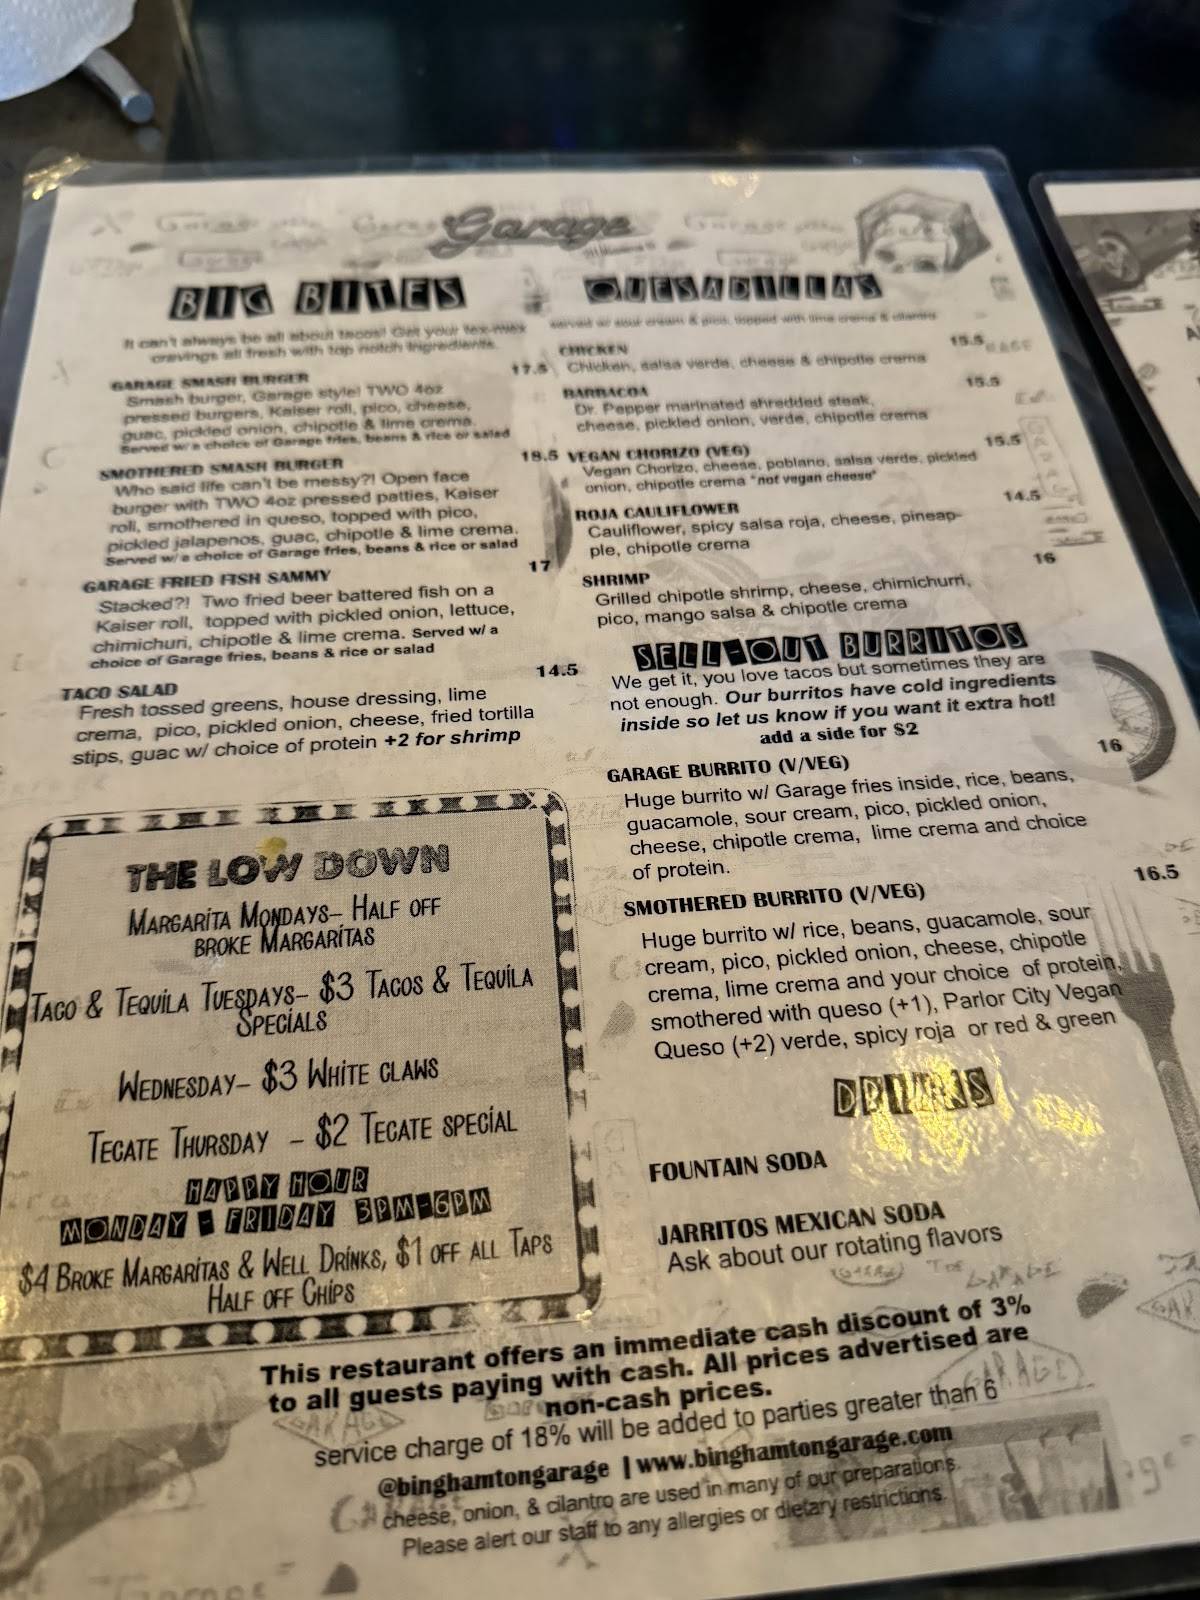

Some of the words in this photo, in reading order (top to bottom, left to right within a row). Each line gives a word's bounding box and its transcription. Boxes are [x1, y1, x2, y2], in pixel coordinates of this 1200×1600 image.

[432, 206, 636, 256] Garage
[168, 284, 274, 321] BIG
[295, 276, 467, 315] BITES
[583, 273, 883, 304] QUESADILLAS
[557, 343, 629, 355] CHICKEN
[950, 335, 984, 348] 15.5
[109, 377, 174, 392] GARAGE
[179, 374, 237, 388] SMASH
[239, 371, 309, 386] BURGER
[511, 363, 548, 377] 17.5
[965, 375, 1000, 389] 15.5
[561, 386, 648, 399] BARBACOA
[567, 448, 620, 462] VEGAN
[625, 446, 700, 460] CHORIZO
[705, 444, 750, 458] (VEG)
[985, 434, 1021, 448] 15.5
[98, 463, 204, 481] SMOTHERED
[208, 460, 267, 475] SMASH
[272, 456, 343, 472] BURGER
[522, 450, 559, 463] 18.5
[574, 506, 618, 520] ROJA
[623, 501, 739, 518] CAULIFLOWER
[1004, 490, 1040, 503] 14.5
[587, 520, 689, 537] Cauliflower,
[688, 517, 734, 537] spicy
[739, 515, 784, 531] salsa
[788, 517, 824, 533] roja,
[830, 511, 895, 527] cheese,
[900, 508, 962, 529] pineap-
[529, 560, 551, 574] 17
[1033, 552, 1056, 565] 16
[82, 576, 152, 593] GARAGE
[158, 573, 214, 589] FRIED
[218, 571, 261, 587] FISH
[266, 569, 330, 585] SAMMY
[582, 571, 649, 588] SHRIMP
[595, 588, 651, 606] Grilled
[657, 585, 725, 606] chipotle
[729, 583, 794, 602] shrimp,
[798, 580, 866, 596] cheese,
[95, 616, 153, 633] Kaiser
[158, 613, 192, 632] roll,
[203, 610, 269, 632] topped
[274, 608, 312, 625] with
[316, 605, 382, 628] pickled
[387, 603, 443, 621] onion,
[448, 602, 514, 618] lettuce,
[633, 633, 828, 672] SELL-OUT
[840, 623, 1028, 659] BURRITOS
[537, 664, 578, 679] 14.5
[611, 673, 642, 689] We
[647, 672, 676, 692] get
[681, 669, 698, 687] it,
[701, 670, 735, 689] you
[740, 666, 778, 682] love
[783, 665, 833, 679] tacos
[836, 660, 867, 676] but
[871, 655, 969, 674] sometimes
[973, 651, 1012, 671] they
[1017, 652, 1046, 665] are
[60, 685, 111, 700] TACO
[115, 682, 178, 698] SALAD
[78, 701, 134, 720] Fresh
[138, 698, 205, 717] tossed
[209, 699, 283, 718] greens,
[289, 693, 349, 709] house
[355, 688, 441, 708] dressing,
[447, 686, 486, 702] lime
[759, 727, 793, 744] add
[799, 729, 811, 741] a
[816, 724, 854, 740] side
[859, 723, 886, 738] for
[893, 720, 918, 736] $2
[1098, 738, 1122, 754] 16
[606, 763, 679, 783] GARAGE
[687, 758, 771, 778] BURRITO
[778, 754, 849, 774] (V/VEG)
[624, 790, 675, 811] Huge
[681, 786, 742, 804] burrito
[747, 783, 768, 801] w/
[775, 782, 846, 802] Garage
[851, 777, 892, 795] fries
[897, 773, 959, 792] inside,
[965, 771, 1005, 790] rice,
[1009, 769, 1074, 786] beans,
[128, 858, 197, 892] THE
[207, 852, 302, 887] LOW
[313, 842, 449, 880] DOWN
[1134, 864, 1180, 883] 16.5
[623, 892, 746, 917] SMOTHERED
[753, 886, 842, 908] BURRITO
[849, 881, 925, 903] (V/VEG)
[264, 1057, 298, 1094] $3
[833, 1066, 995, 1118] DRIS
[649, 1155, 758, 1183] FOUNTAIN
[765, 1149, 826, 1173] SODA
[184, 1173, 279, 1205] HAPPY
[288, 1167, 369, 1197] HOUR
[59, 1211, 187, 1246] MONDAY
[224, 1200, 335, 1234] FRIDAY
[354, 1188, 491, 1224] 3PM-6PM
[658, 1217, 768, 1246] JARRITOS
[775, 1207, 876, 1235] MEXICAN
[883, 1201, 944, 1226] SODA
[667, 1249, 710, 1273] Ask
[718, 1245, 784, 1268] about
[790, 1244, 827, 1262] our
[835, 1231, 921, 1257] rotating
[926, 1227, 1002, 1249] flavors
[260, 1361, 320, 1385] This
[329, 1348, 474, 1379] restaurant
[483, 1341, 564, 1365] offers
[572, 1338, 605, 1357] an
[613, 1324, 756, 1353] immediate
[763, 1313, 828, 1339] cash
[836, 1305, 949, 1333] discount
[957, 1299, 981, 1322] of
[992, 1295, 1031, 1319] 3%
[268, 1394, 296, 1413] to
[306, 1385, 340, 1409] all
[349, 1380, 442, 1411] guests
[451, 1369, 542, 1401] paying
[551, 1359, 611, 1386] with
[619, 1353, 692, 1379] cash.
[703, 1347, 737, 1371] All
[745, 1343, 829, 1373] prices
[838, 1324, 978, 1358] advertised
[985, 1325, 1028, 1344] are
[544, 1385, 670, 1417] non-cash
[678, 1381, 771, 1411] prices.
[314, 1440, 397, 1467] service
[404, 1434, 483, 1459] charge
[491, 1426, 513, 1449] of
[521, 1420, 570, 1446] 18%
[577, 1416, 614, 1441] will
[620, 1414, 649, 1437] be
[656, 1405, 727, 1433] added
[733, 1406, 755, 1425] to
[761, 1396, 838, 1429] parties
[844, 1391, 922, 1420] greater
[928, 1383, 978, 1406] than
[983, 1378, 997, 1401] 6
[378, 1459, 609, 1502] @binghamtongarage
[636, 1426, 954, 1472] www.binghamtongarage.com
